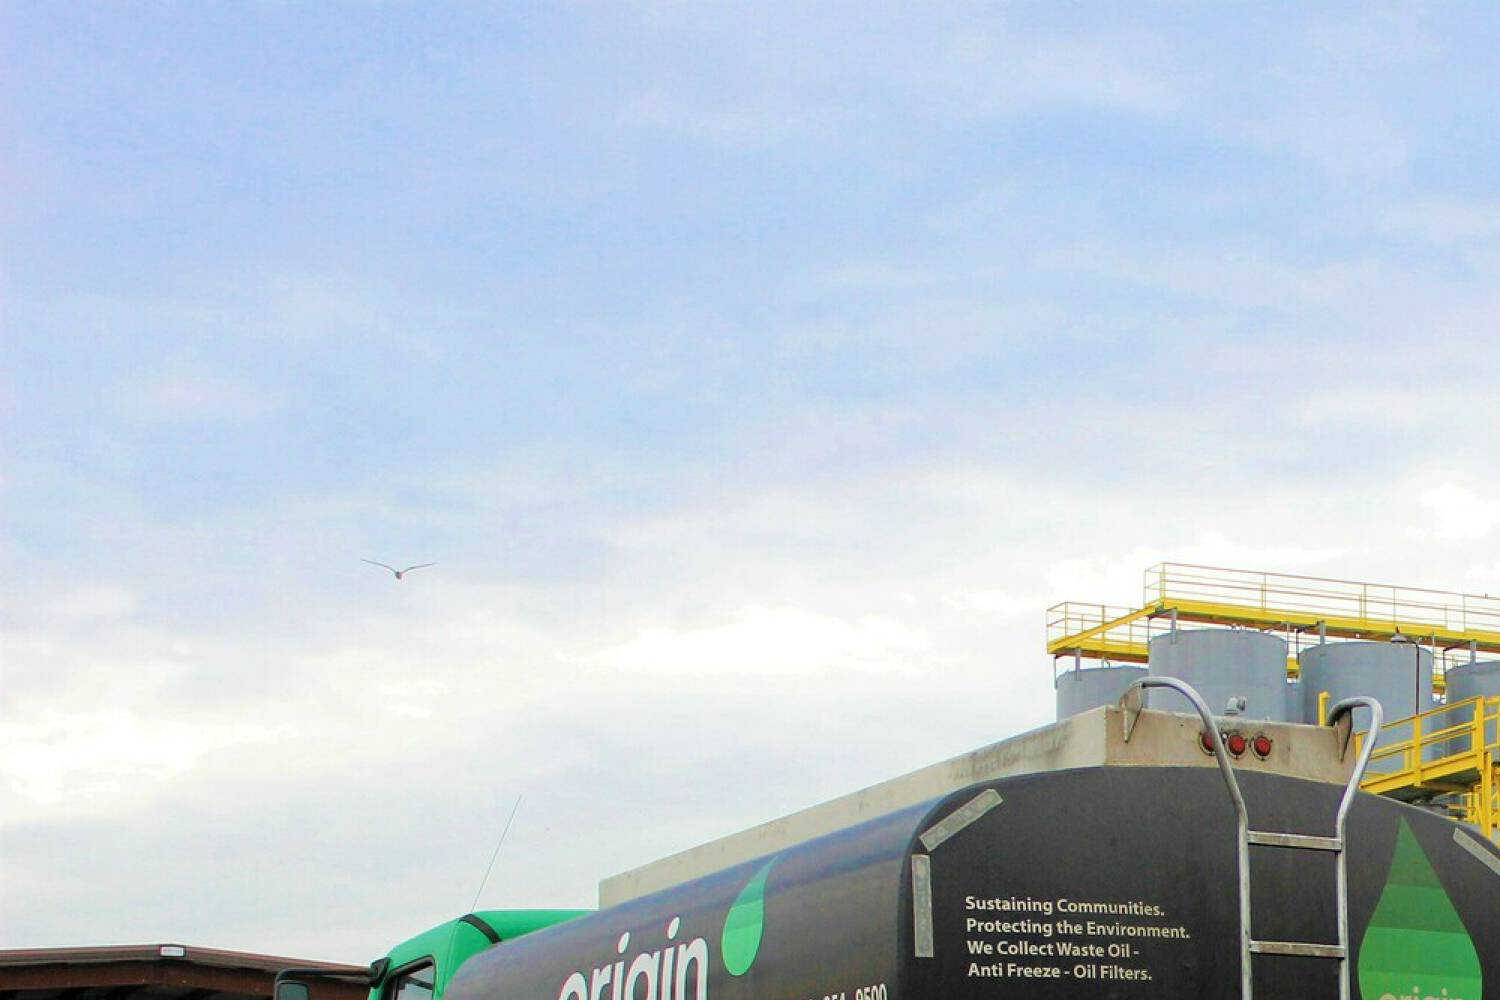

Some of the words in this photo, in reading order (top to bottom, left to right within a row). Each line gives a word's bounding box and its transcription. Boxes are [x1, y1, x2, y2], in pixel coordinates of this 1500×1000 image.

[965, 896, 1054, 915] Sustaining
[1057, 899, 1165, 916] Communities.
[966, 918, 1053, 937] Protecting
[1056, 920, 1083, 935] the
[1087, 921, 1190, 939] Environment.
[967, 940, 993, 955] We
[997, 941, 1054, 956] Collect
[1056, 942, 1105, 957] Waste
[1108, 944, 1130, 958] Oil
[967, 963, 1003, 978] Anti
[1007, 963, 1061, 978] Freeze
[1073, 964, 1096, 979] Oil
[1100, 965, 1152, 981] Filters.
